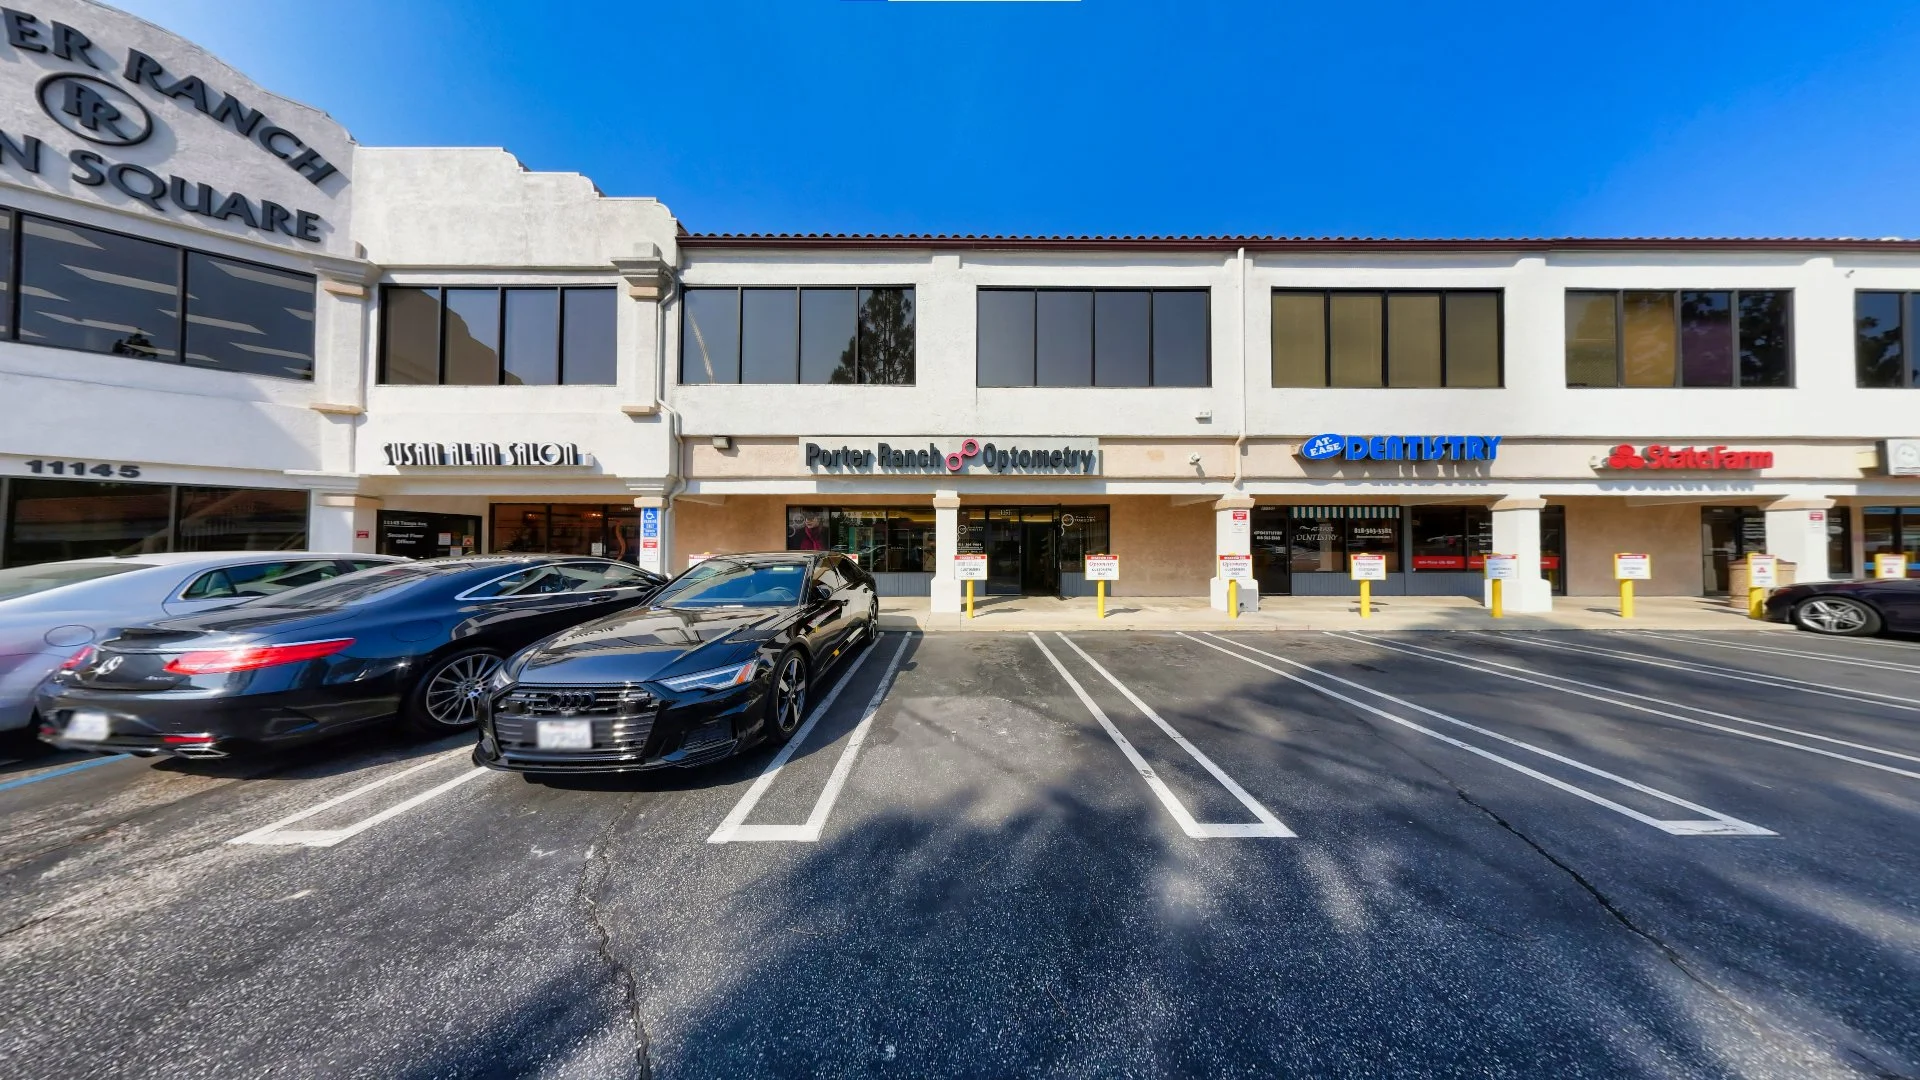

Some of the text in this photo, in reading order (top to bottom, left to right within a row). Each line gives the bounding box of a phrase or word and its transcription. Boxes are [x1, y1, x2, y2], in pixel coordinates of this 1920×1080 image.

[122, 47, 338, 187] RANCH
[69, 149, 322, 243] SQUARE
[383, 442, 577, 466] SUSAN ALAN SALON
[1310, 443, 1341, 456] EASE
[1314, 438, 1333, 448] AT-
[1345, 435, 1501, 461] DENTISTRY
[24, 459, 141, 479] 11145
[805, 442, 1093, 473] Porter Ranch Optometry
[1296, 533, 1338, 541] DENTISTRY
